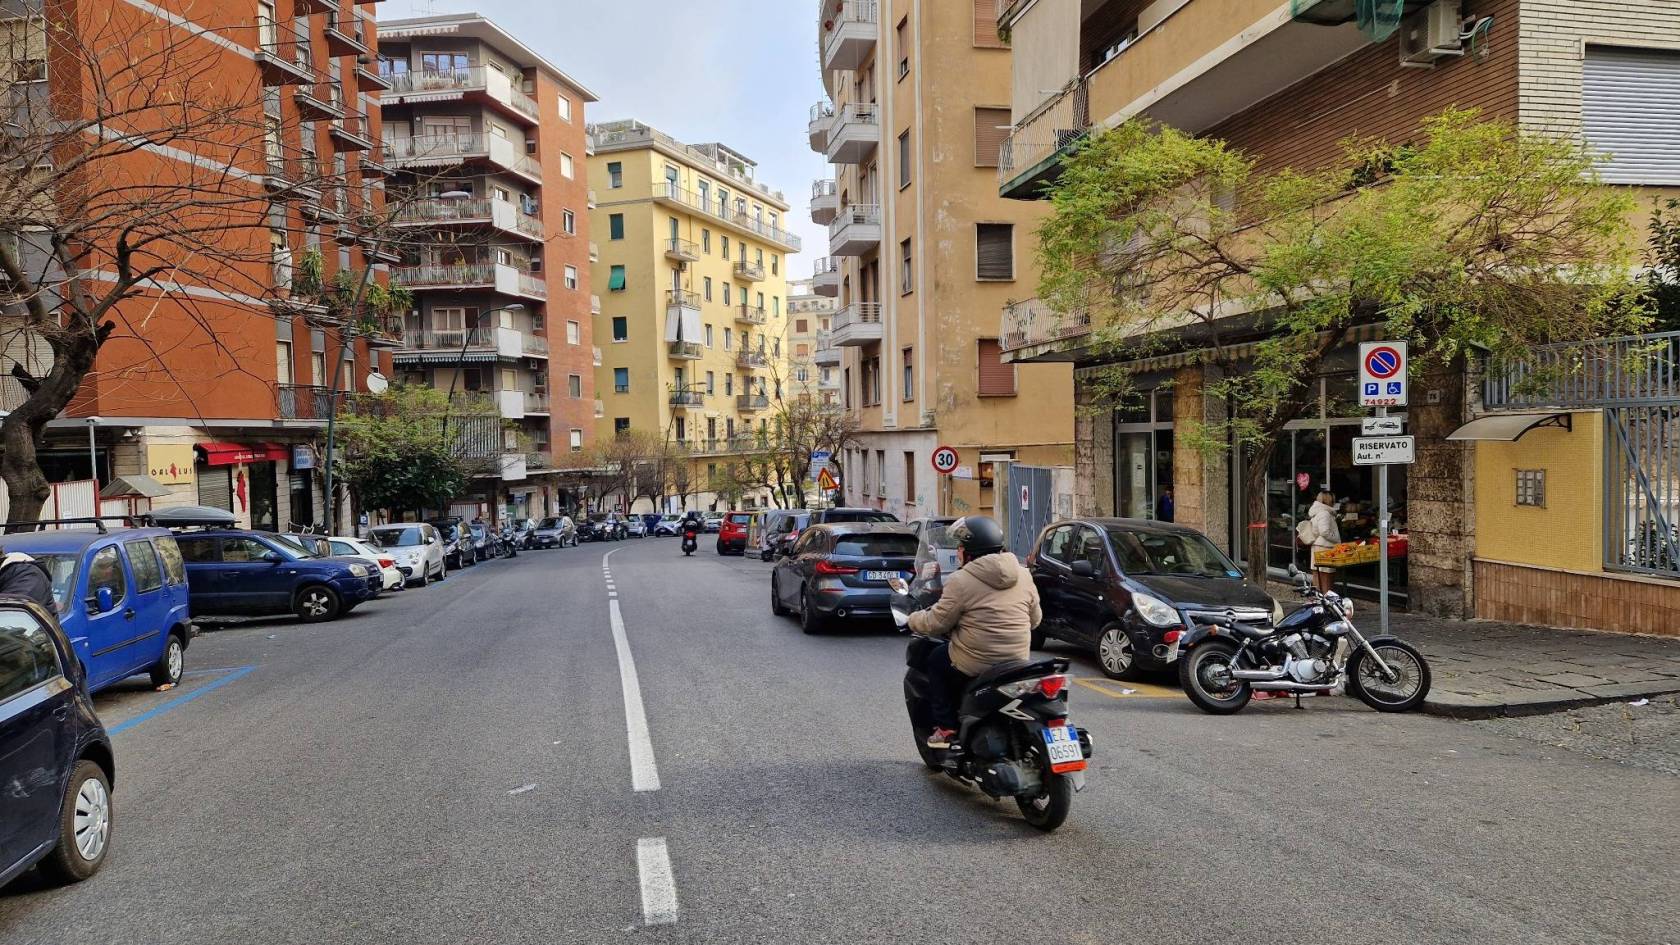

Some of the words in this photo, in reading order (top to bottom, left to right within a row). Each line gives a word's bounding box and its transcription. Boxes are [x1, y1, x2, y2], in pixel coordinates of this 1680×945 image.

[1359, 441, 1408, 450] RISERVATO
[938, 453, 953, 466] 30
[1356, 452, 1373, 460] Aut.
[1050, 744, 1080, 760] 06591
